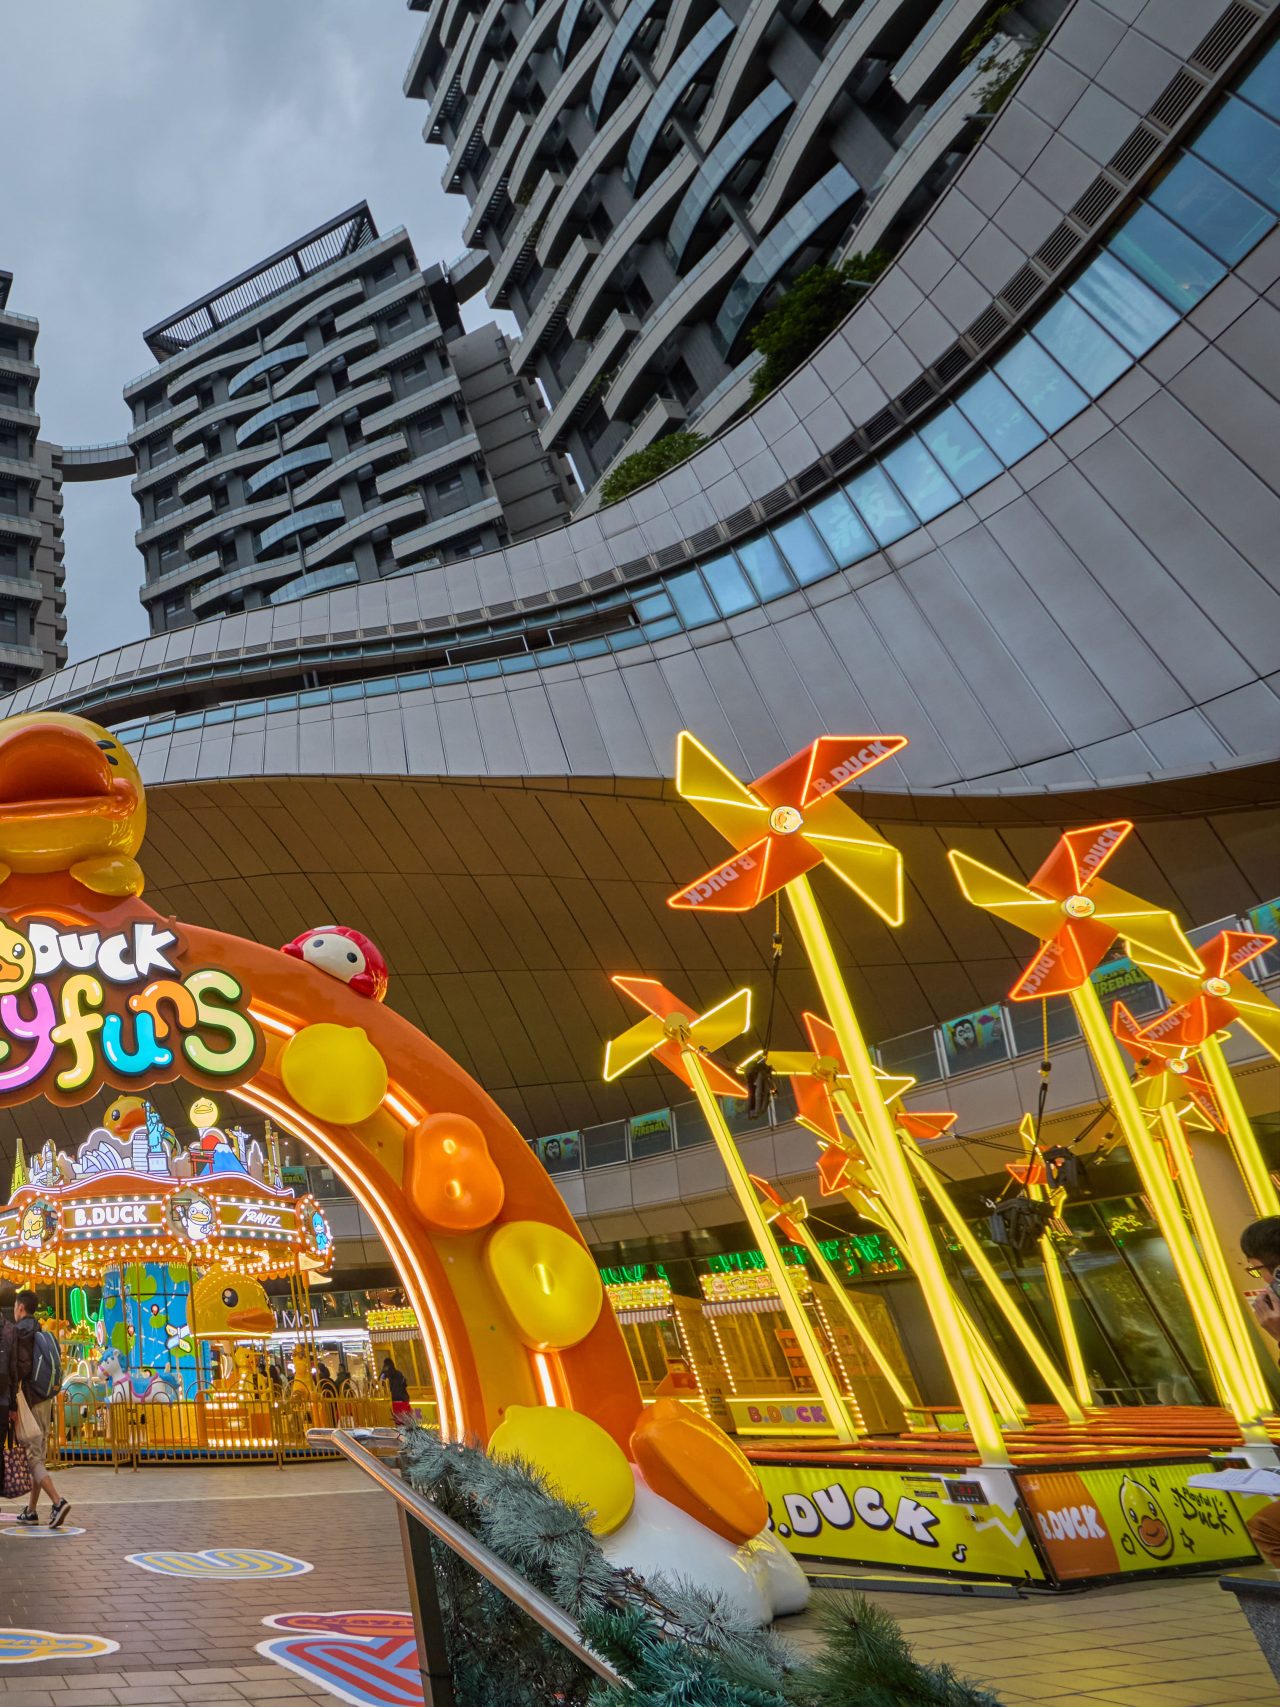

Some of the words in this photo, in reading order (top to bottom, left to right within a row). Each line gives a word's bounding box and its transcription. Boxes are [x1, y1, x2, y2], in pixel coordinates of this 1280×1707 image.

[811, 738, 890, 793] B.DUCK
[74, 1205, 148, 1226] B.DUCK
[747, 1406, 827, 1424] B.DUCK
[1037, 1504, 1106, 1541] B.DUCK
